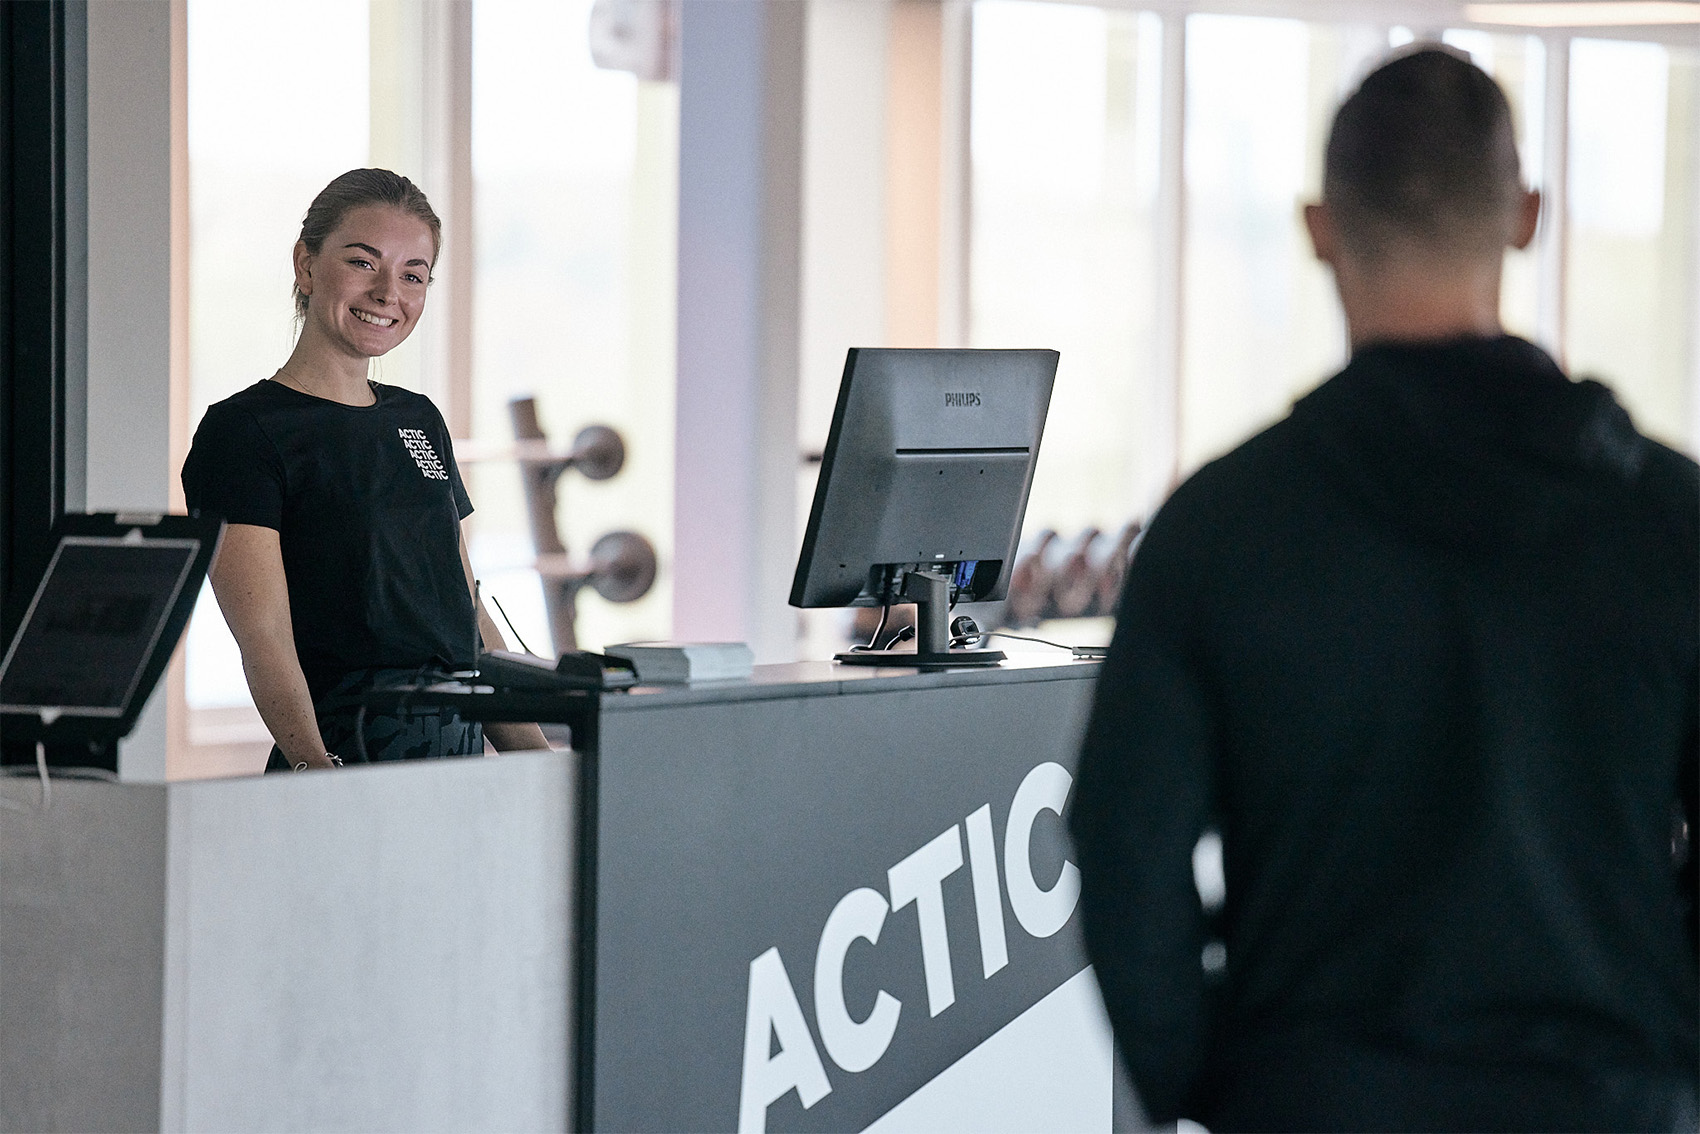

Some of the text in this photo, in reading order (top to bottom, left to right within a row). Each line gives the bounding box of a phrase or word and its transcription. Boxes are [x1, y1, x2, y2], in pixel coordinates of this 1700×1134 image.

[945, 392, 981, 407] PHILIPS
[398, 428, 426, 440] ACTIC
[403, 439, 432, 450] ACTIC
[409, 449, 438, 460] ACTIC
[415, 459, 443, 470] ACTIC
[421, 468, 449, 480] ACTIC
[738, 762, 1082, 1134] ACTIC
